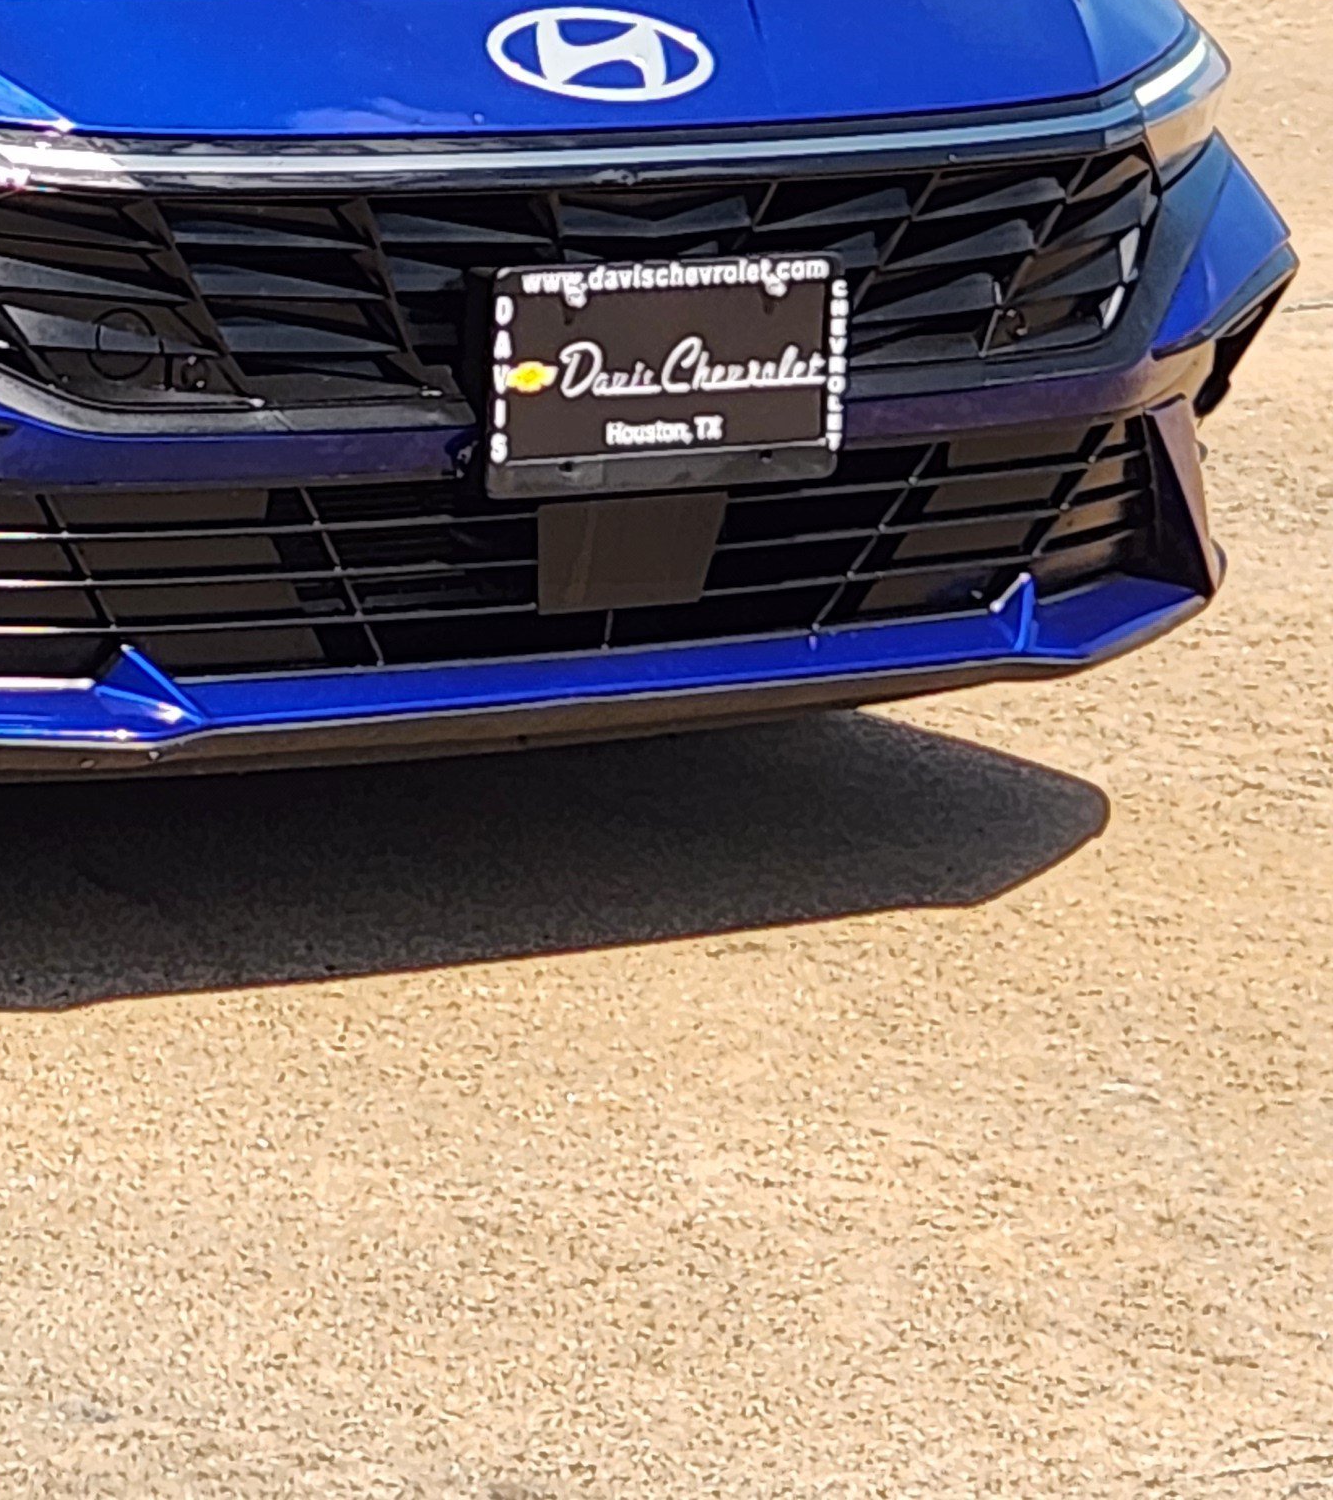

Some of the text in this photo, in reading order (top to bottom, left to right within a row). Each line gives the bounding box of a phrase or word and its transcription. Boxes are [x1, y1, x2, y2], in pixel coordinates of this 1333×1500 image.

[520, 258, 831, 294] www.davischevrolet.com
[492, 295, 515, 463] DAVIS
[559, 336, 827, 398] Davis Chevrolet
[605, 414, 725, 446] Houston, TX
